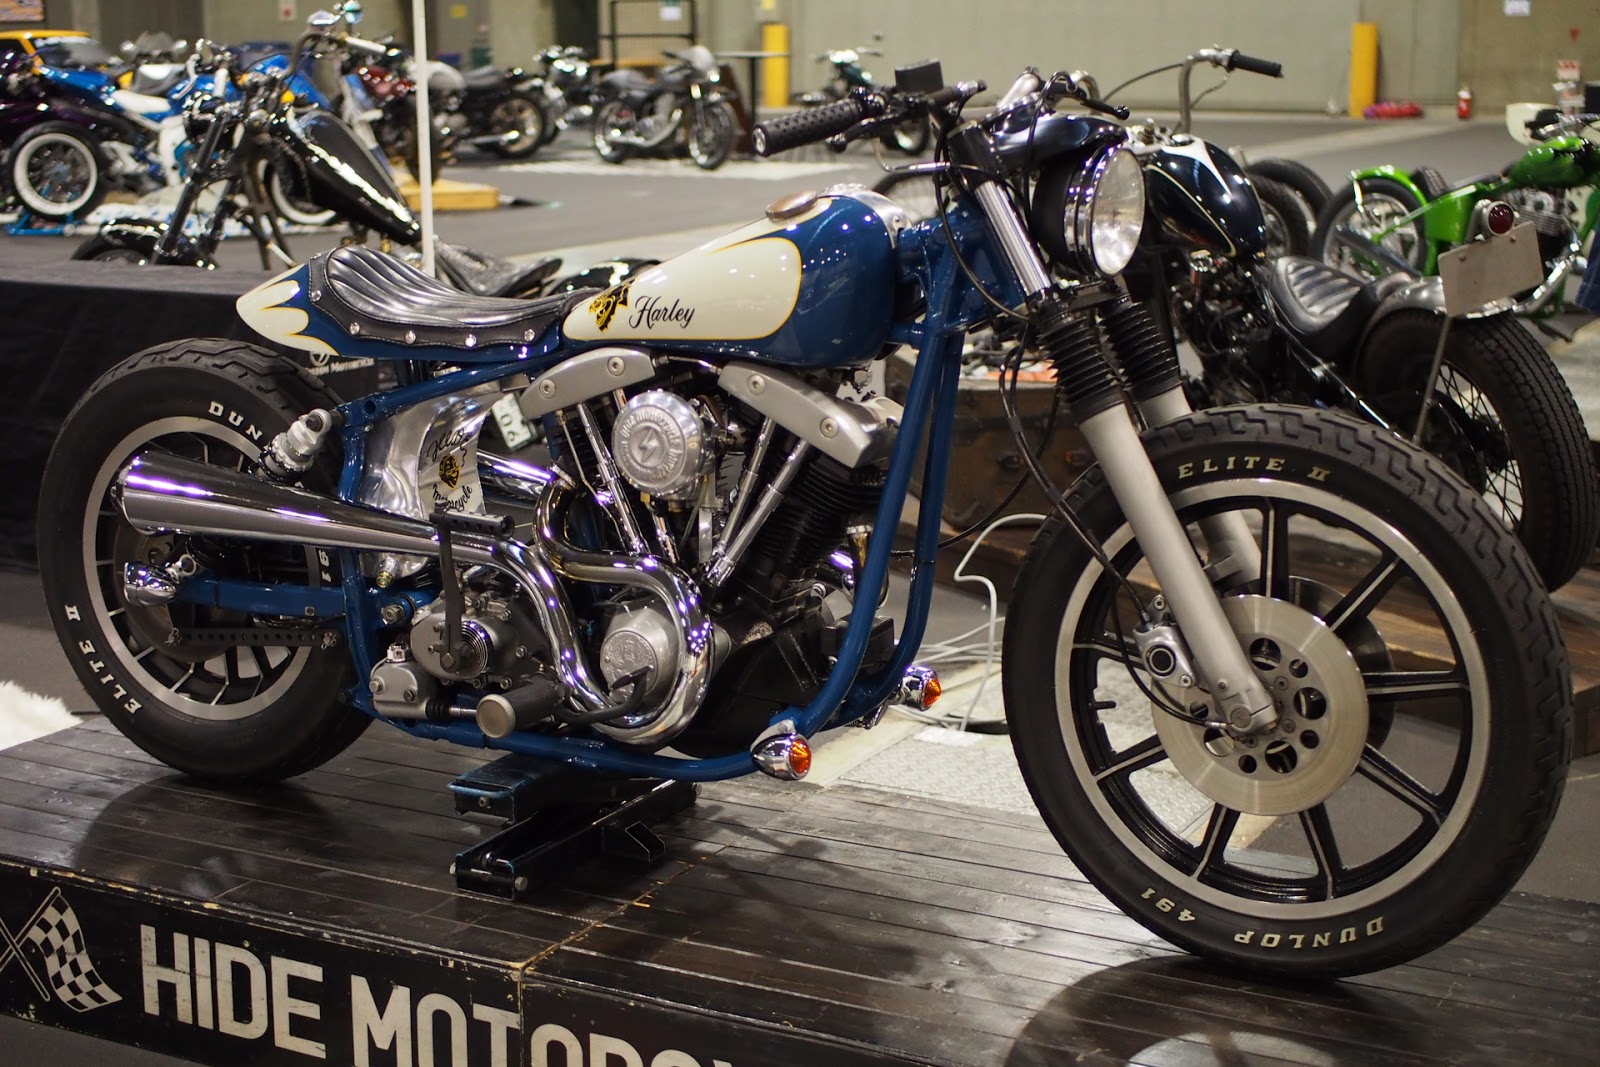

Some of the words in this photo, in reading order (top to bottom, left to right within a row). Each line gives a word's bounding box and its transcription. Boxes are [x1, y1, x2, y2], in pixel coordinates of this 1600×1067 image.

[628, 295, 695, 329] Harley
[1177, 455, 1286, 479] ELITE
[1307, 465, 1332, 482] II
[64, 604, 81, 621] II
[78, 639, 143, 714] ELITE
[1140, 887, 1196, 922] 491
[1233, 916, 1385, 949] DUNLOP
[140, 923, 327, 1058] HIDE
